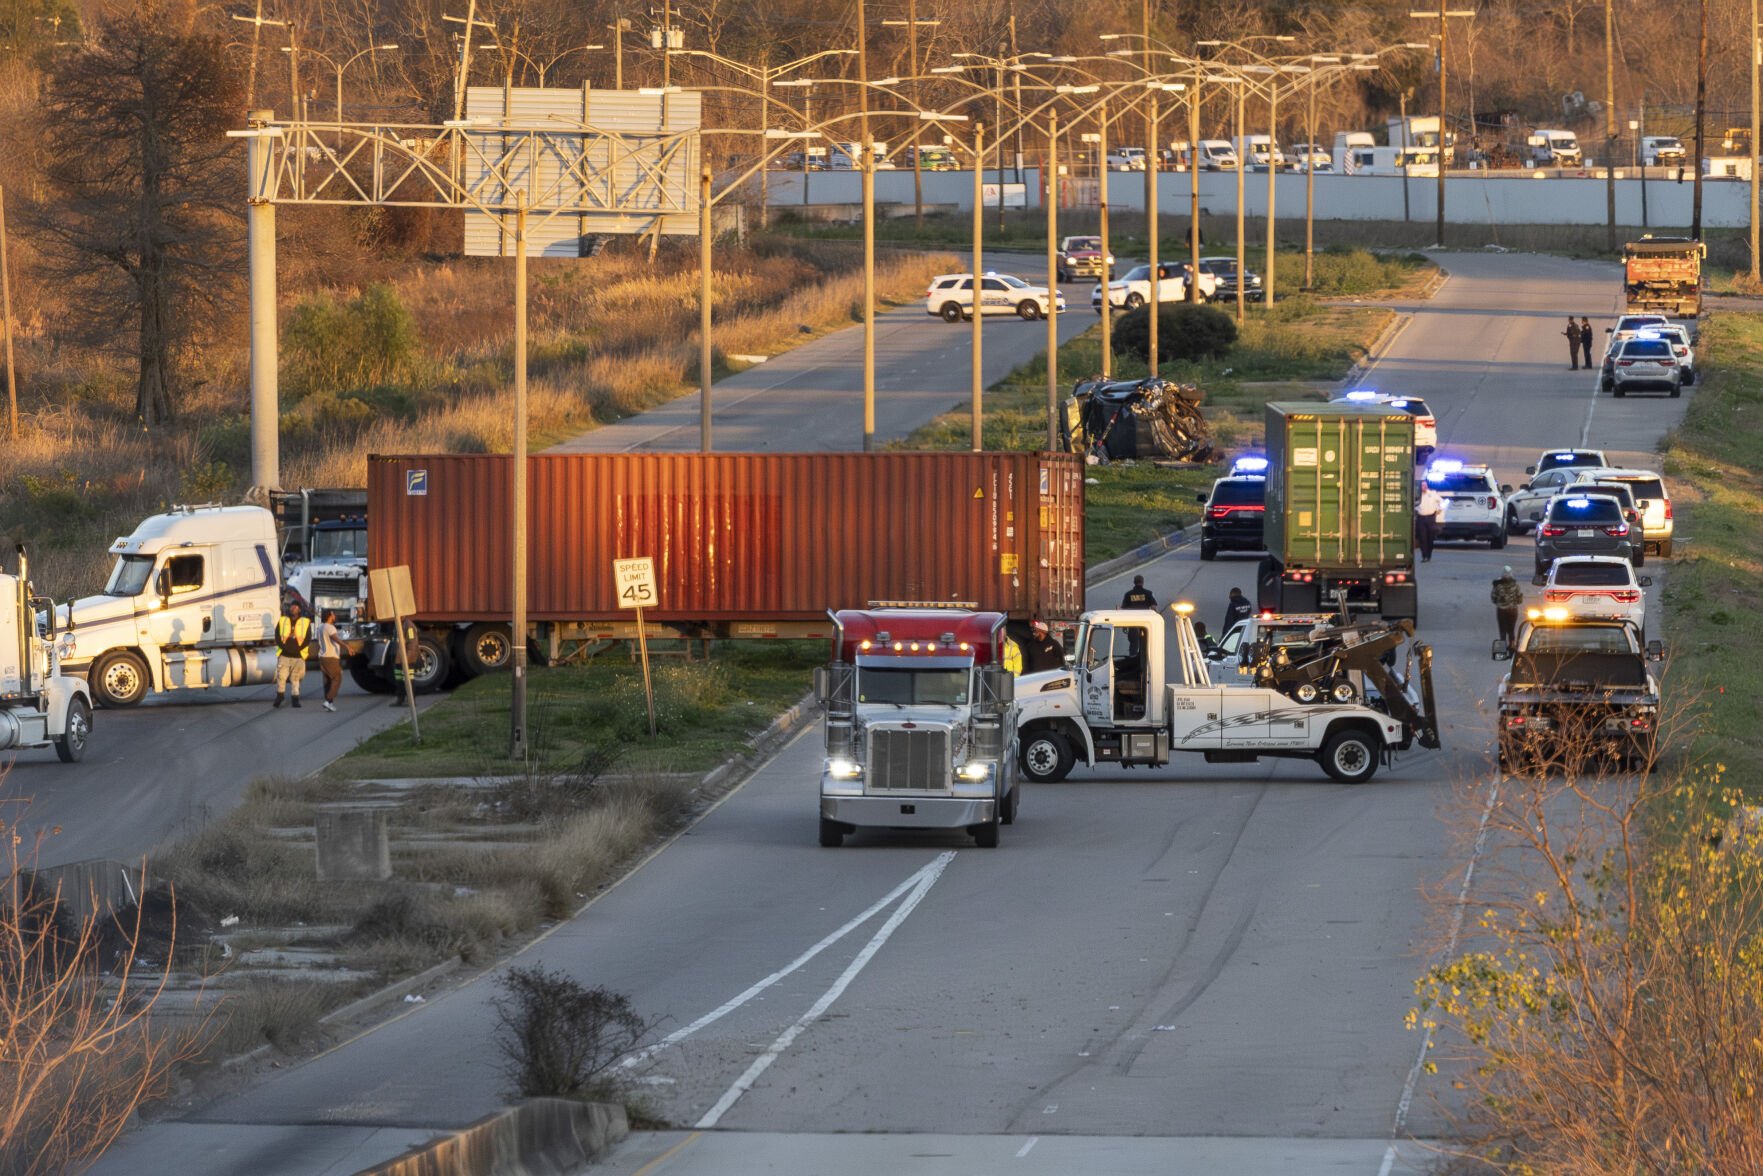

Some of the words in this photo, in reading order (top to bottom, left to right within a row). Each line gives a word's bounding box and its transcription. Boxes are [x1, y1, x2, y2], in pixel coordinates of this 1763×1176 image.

[620, 563, 649, 572] SPEED
[624, 572, 646, 582] LIMIT
[622, 583, 652, 601] 45
